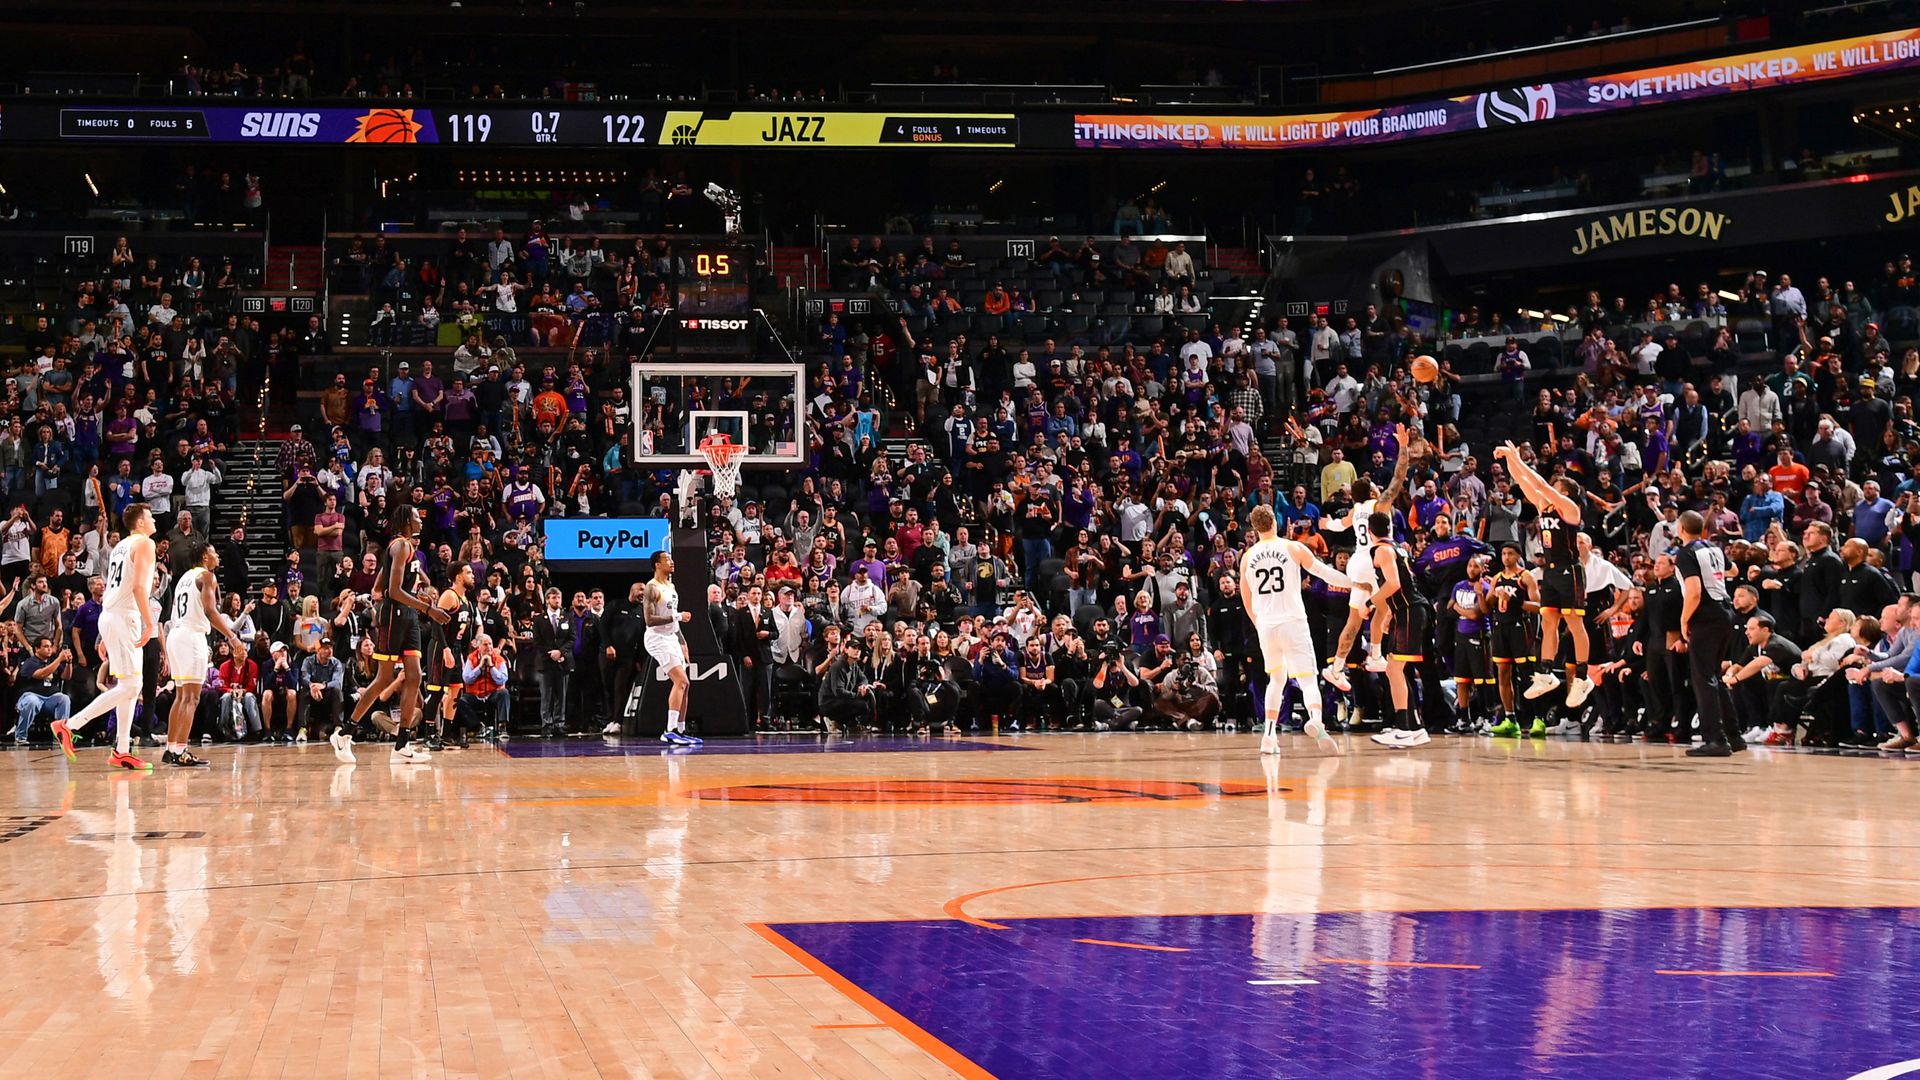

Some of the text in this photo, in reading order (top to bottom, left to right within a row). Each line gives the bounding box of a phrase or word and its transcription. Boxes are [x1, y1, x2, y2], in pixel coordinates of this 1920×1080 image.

[1588, 38, 1920, 104] SOMETHINGINKED WE WILL LIGH
[77, 118, 193, 129] TIMEOUTS 0 FOULS 5
[240, 112, 321, 137] SUNS
[449, 114, 492, 143] 119
[531, 112, 561, 134] 0.7
[602, 114, 645, 143] 122
[762, 116, 825, 142] JAZZ
[897, 125, 938, 135] 4 FOULS
[956, 125, 1007, 136] 1 TIMEOUTS
[1221, 125, 1241, 141] WE
[1245, 124, 1276, 141] WILL
[1280, 123, 1318, 141] LIGHT
[1322, 121, 1340, 139] UP
[1343, 115, 1379, 137] YOUR
[1382, 108, 1447, 134] BRANDING
[536, 134, 558, 144] QTR 4
[912, 133, 943, 143] BONUS
[1571, 208, 1726, 256] JAMESON
[70, 240, 89, 254] 119
[1012, 243, 1030, 256] 121
[696, 254, 729, 275] 0.5
[246, 300, 262, 310] 119
[295, 300, 311, 310] 120
[853, 302, 868, 312] 121
[1291, 304, 1305, 314] 121
[698, 319, 748, 330] TISSOT
[578, 530, 648, 554] PayPal
[1358, 524, 1369, 546] 3
[1543, 531, 1552, 548] 8
[1250, 549, 1288, 570] MARKKANEN
[1433, 546, 1460, 563] SUNS
[110, 560, 124, 588] 24
[1255, 566, 1285, 595] 23
[177, 592, 188, 619] 13
